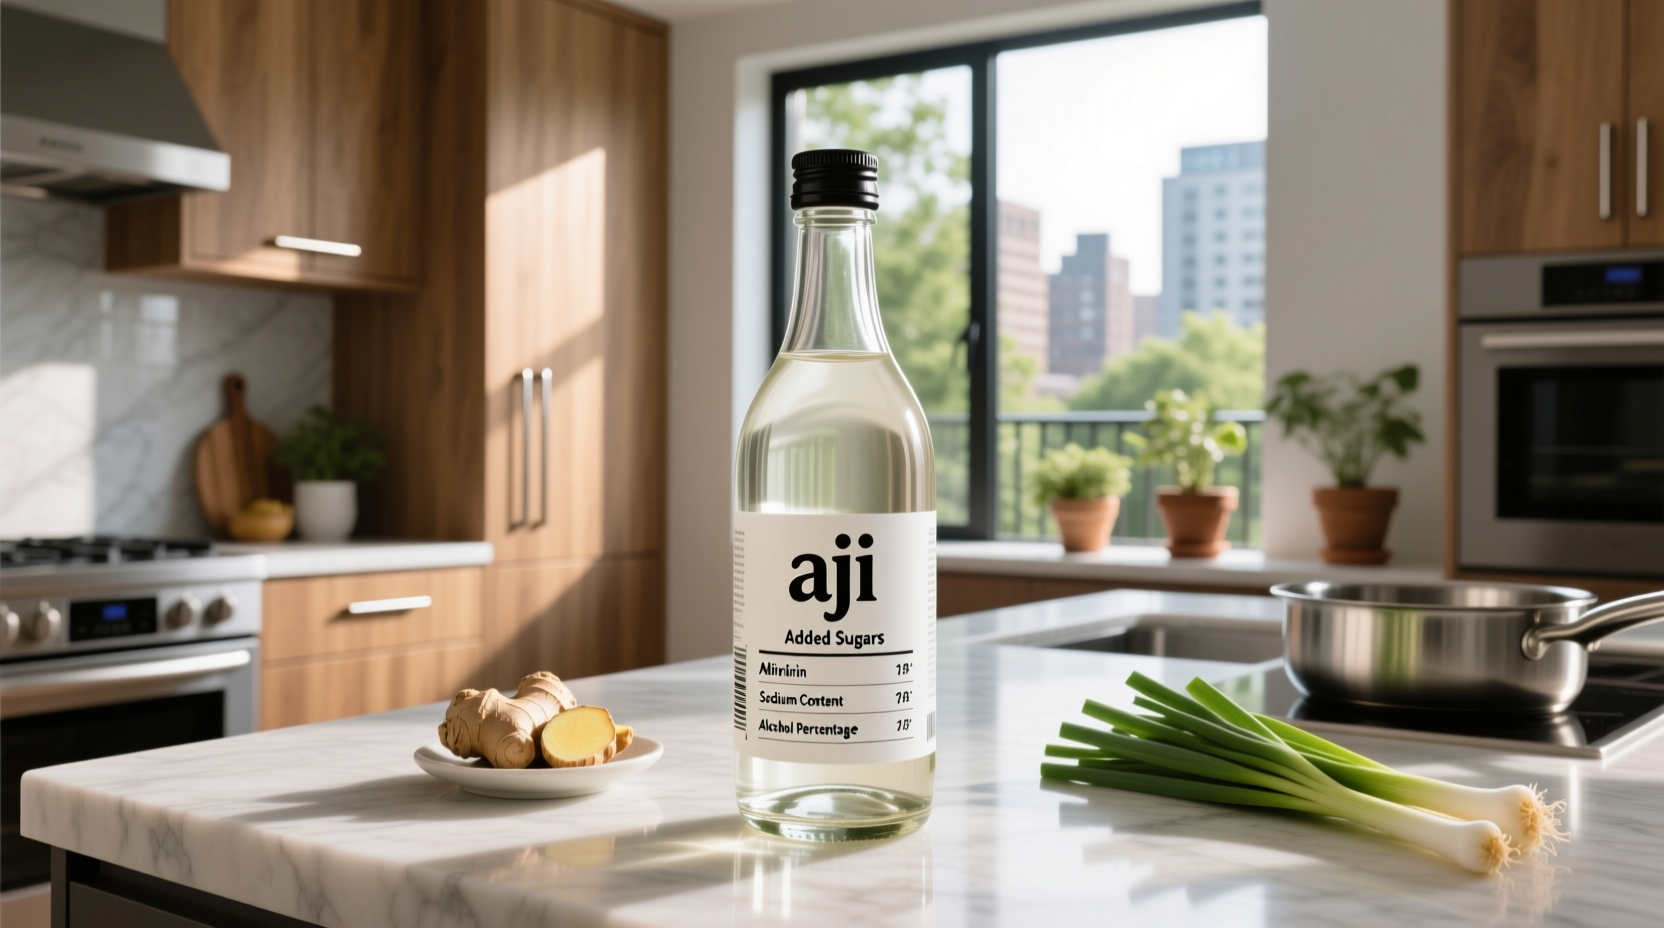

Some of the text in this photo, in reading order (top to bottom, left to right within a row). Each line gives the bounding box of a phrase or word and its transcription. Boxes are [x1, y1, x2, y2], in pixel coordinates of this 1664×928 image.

[789, 533, 877, 622] aji
[785, 630, 884, 650] Added Sugars
